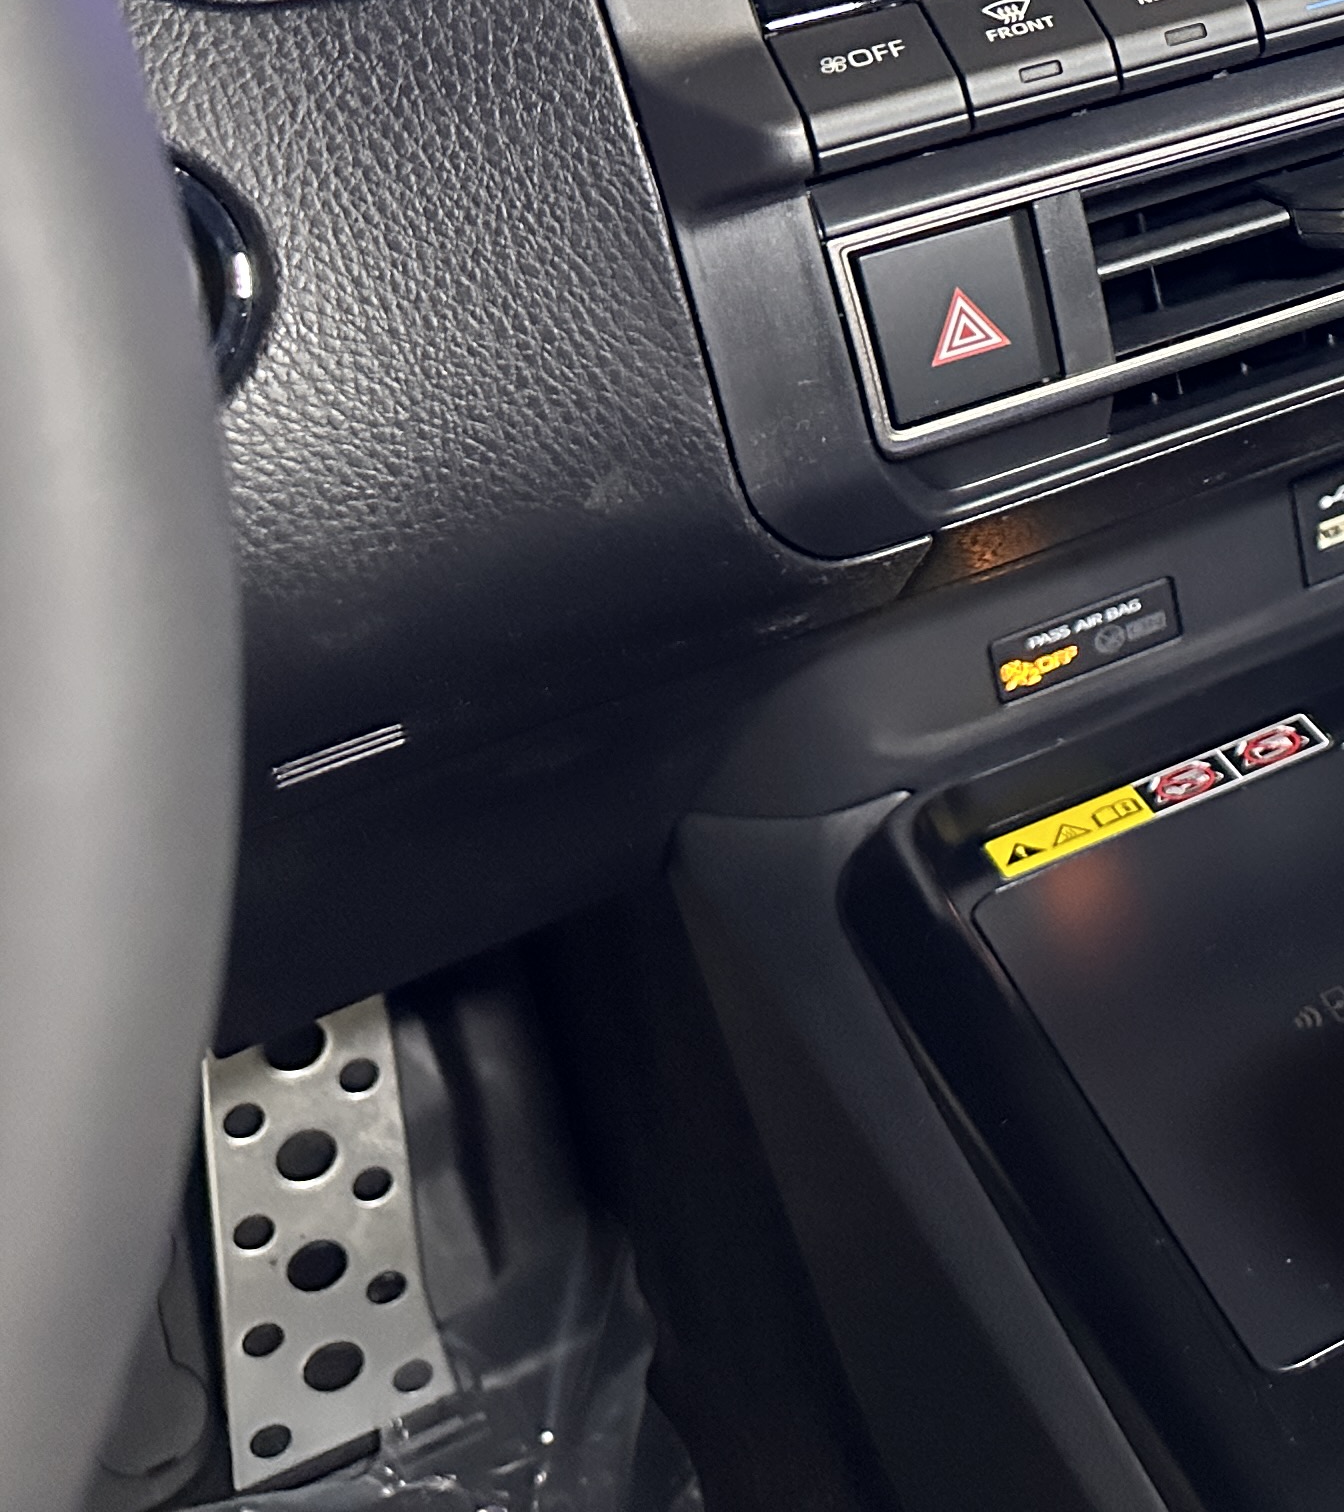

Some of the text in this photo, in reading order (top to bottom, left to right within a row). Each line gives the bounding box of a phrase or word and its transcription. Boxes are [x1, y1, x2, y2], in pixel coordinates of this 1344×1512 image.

[985, 13, 1055, 43] FRONT
[847, 38, 907, 69] OFF
[1025, 624, 1072, 651] PASS
[1072, 612, 1104, 634] AIR
[1103, 598, 1143, 623] BAG
[1035, 644, 1079, 675] OFF
